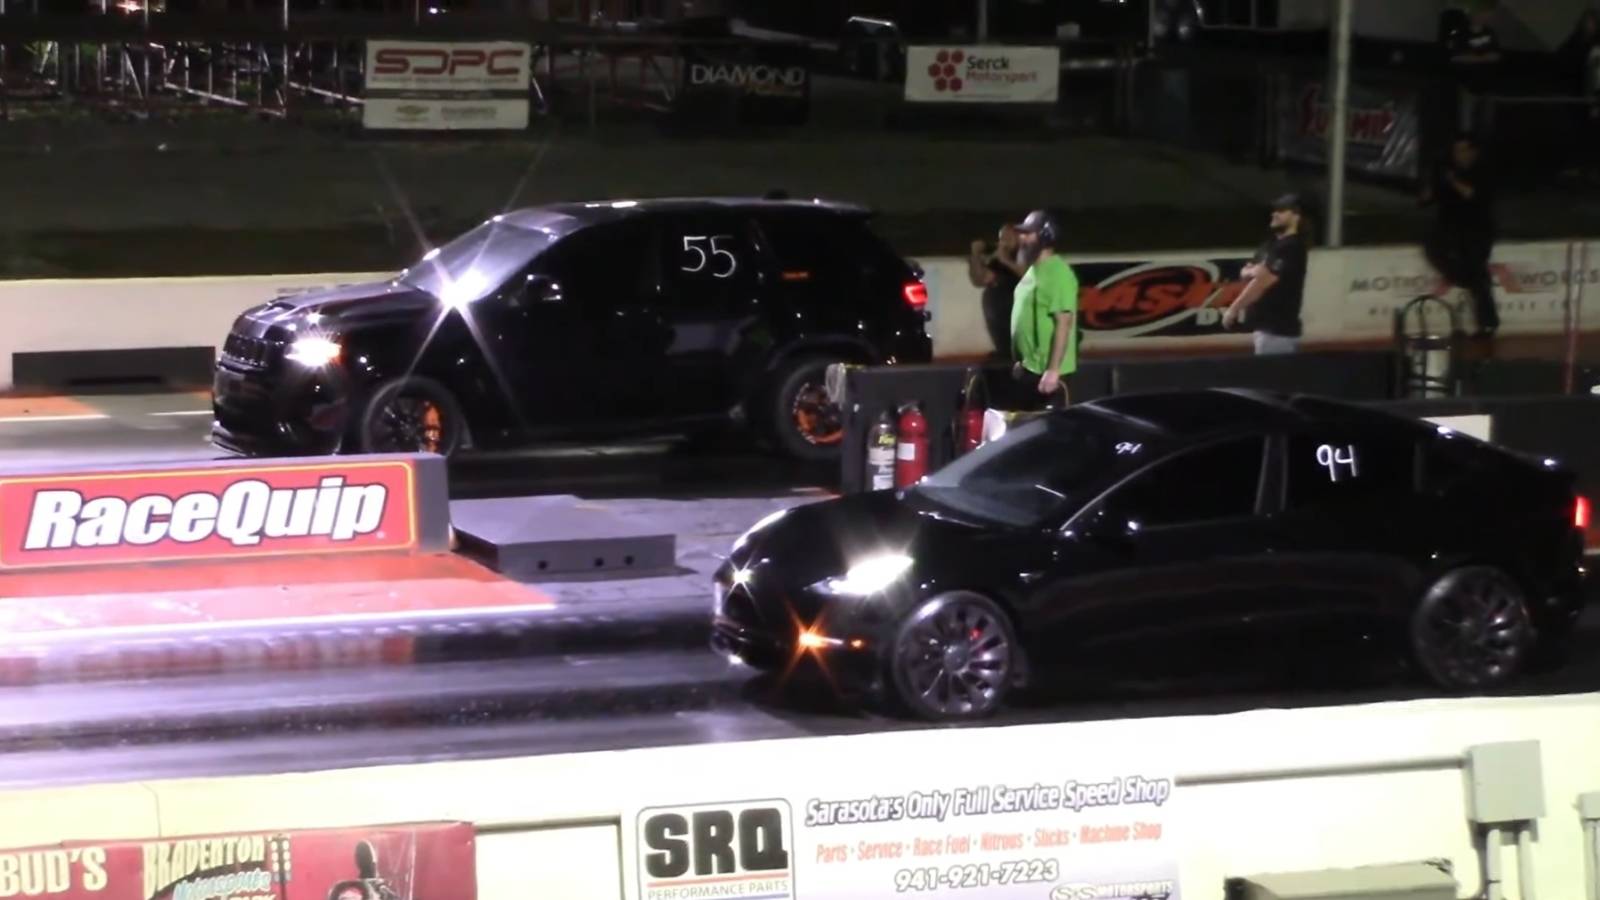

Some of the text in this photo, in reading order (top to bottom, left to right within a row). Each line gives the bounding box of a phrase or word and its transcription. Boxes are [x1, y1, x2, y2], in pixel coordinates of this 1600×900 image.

[374, 48, 524, 76] SDPC
[691, 64, 806, 86] DIAMOND
[967, 55, 1010, 70] Serck
[681, 235, 737, 278] 55
[1115, 441, 1142, 455] 94
[1316, 444, 1358, 482] 94
[21, 475, 389, 551] RaceQuip
[805, 775, 1170, 827] Sarasota's Only Full Service Speed Shop
[645, 808, 788, 878] SRQ
[816, 821, 1162, 864] Parts Service Race Fuel Nitrous Slicks Machine Shop
[0, 846, 108, 898] BUD'S
[143, 835, 265, 900] BRADENTON
[895, 858, 1059, 892] 941-921-7223
[647, 880, 789, 900] PERFORMANCE PARTS
